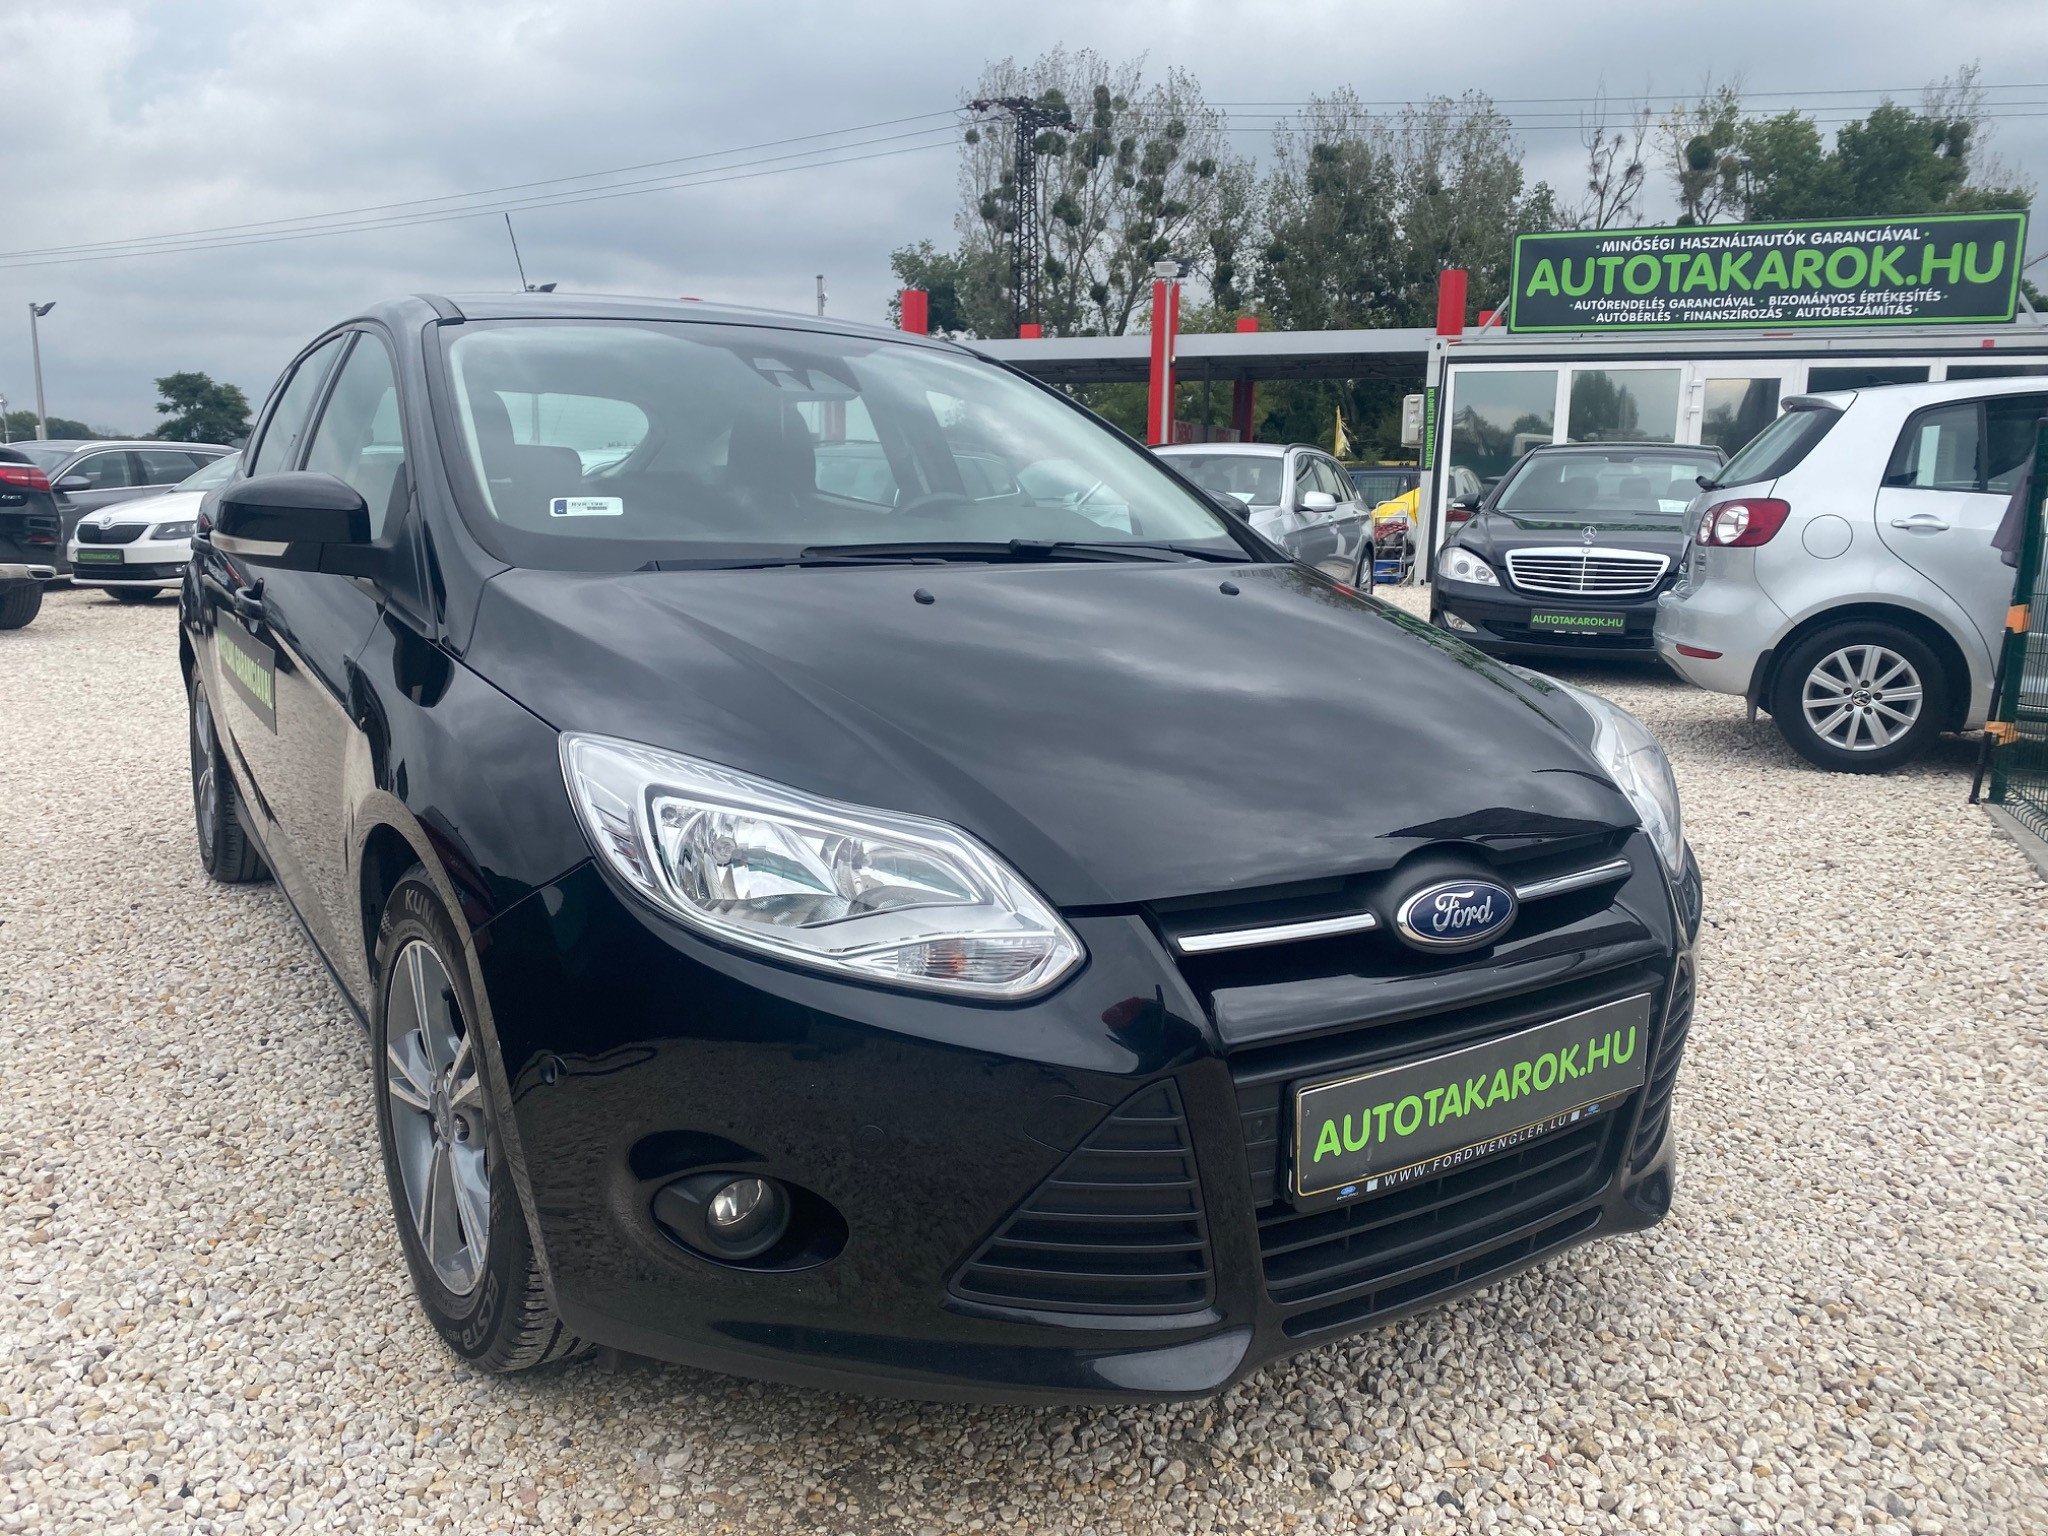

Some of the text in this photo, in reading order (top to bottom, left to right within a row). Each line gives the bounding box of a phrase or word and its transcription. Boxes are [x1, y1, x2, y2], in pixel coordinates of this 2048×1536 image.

[1601, 227, 1921, 253] MINŐSÉGI HASZNÁLTAUTÓK GARANCIÁVAL
[1526, 241, 2006, 298] AUTOTAKAROK.HU
[1574, 288, 1941, 311] AUTÓRENDELÉS GARANCIÁVAL BIZOMÁNYOS ÉRTÉKESÍTÉS
[1596, 303, 1913, 323] AUTÓBÉRLÉS FINANSZÍROZÁS AUTÓBESZÁMÍTÁS
[1532, 614, 1624, 628] AUTOTAKAROK.HU
[1432, 890, 1494, 932] Ford
[1313, 1025, 1637, 1163] AUTOTAKAROK.HU
[1384, 1115, 1568, 1187] WWW.FORDWENGLER.LU
